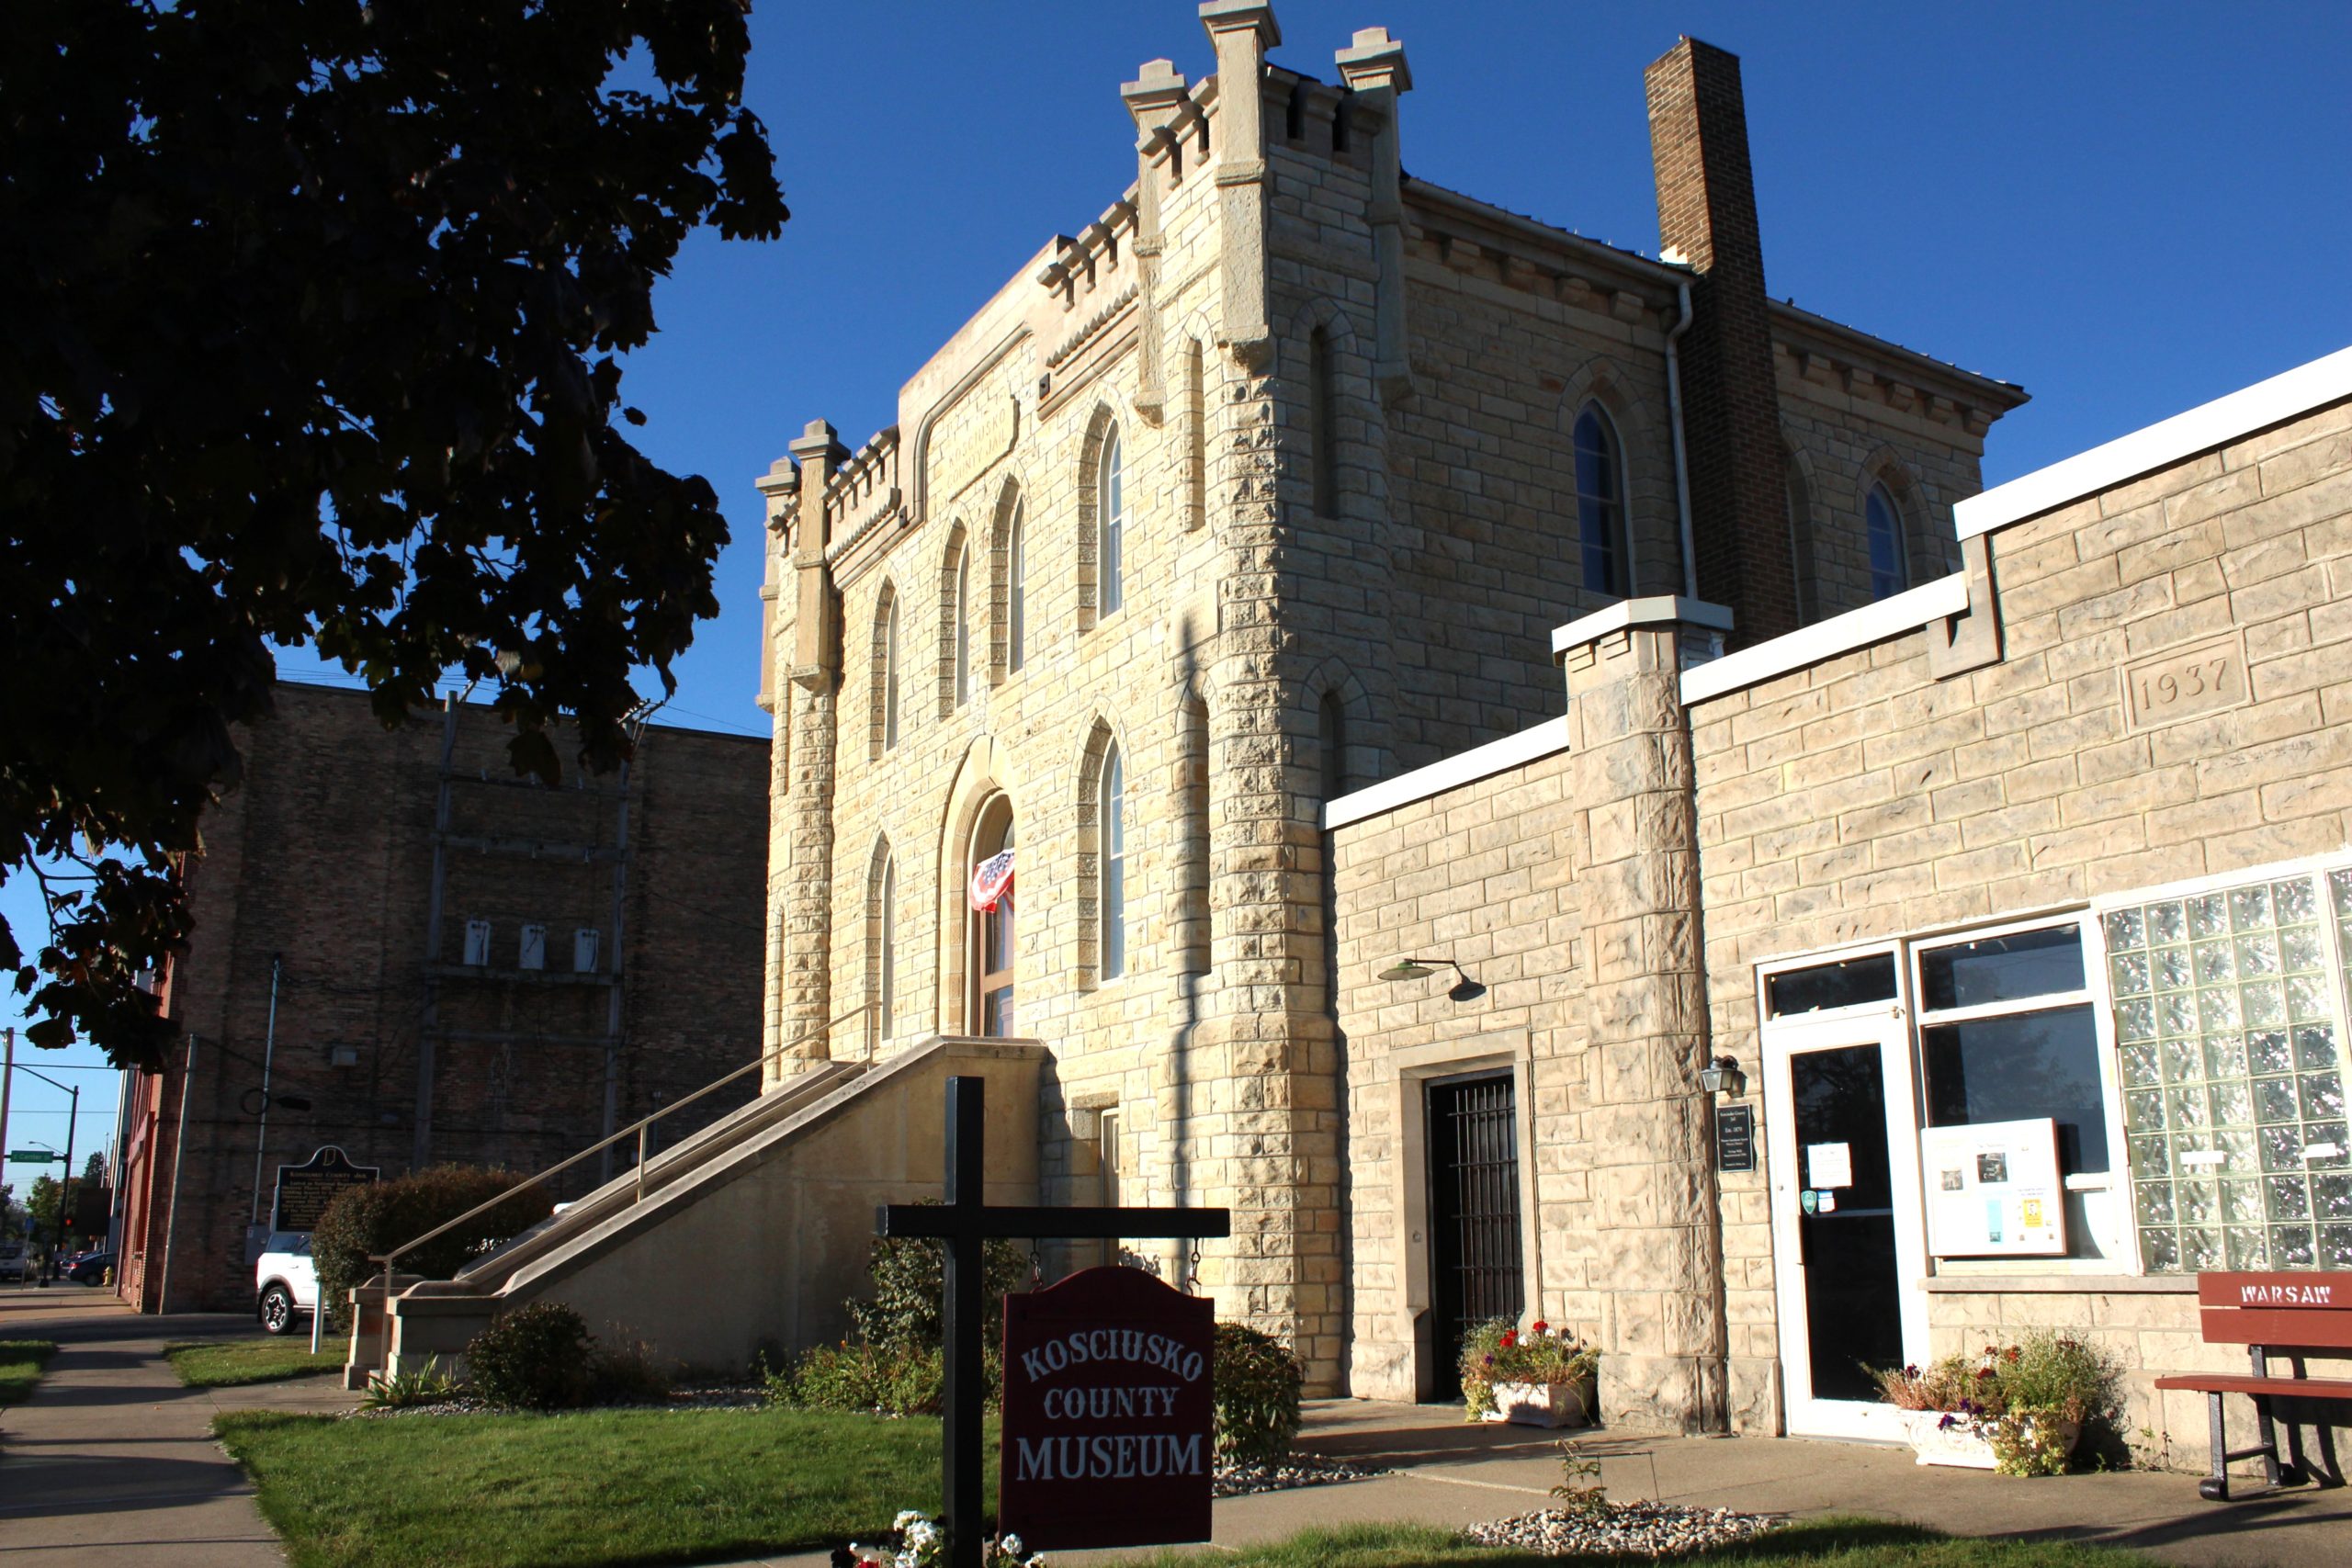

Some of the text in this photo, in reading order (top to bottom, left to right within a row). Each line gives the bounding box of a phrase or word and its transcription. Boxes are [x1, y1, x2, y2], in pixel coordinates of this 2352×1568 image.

[947, 428, 1008, 490] COUNTY JAIL
[949, 408, 1006, 468] KOSCIUSKO
[2141, 656, 2227, 711] 1937
[2241, 1286, 2331, 1303] WARSAW
[1021, 1329, 1204, 1382] KOSCIUSKO
[1043, 1386, 1181, 1420] COUNTY
[1016, 1433, 1204, 1482] MUSEUM
